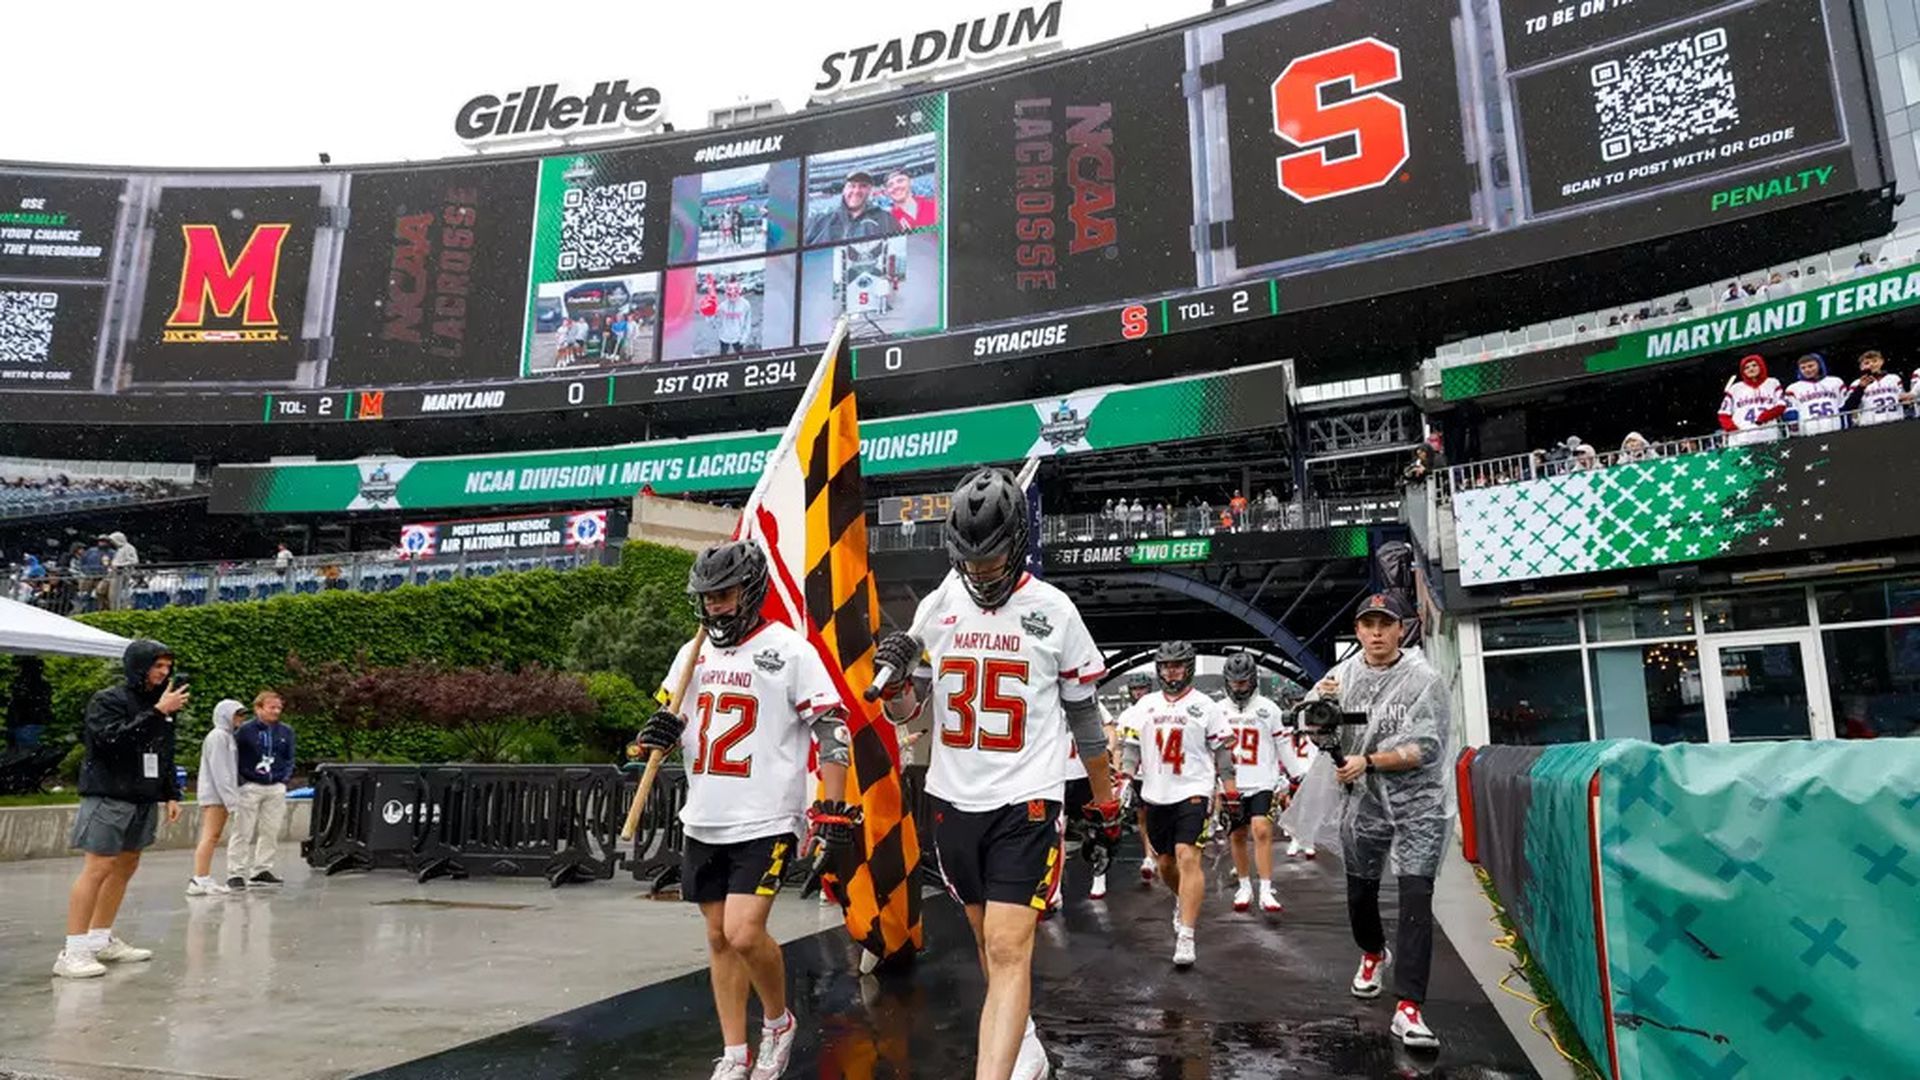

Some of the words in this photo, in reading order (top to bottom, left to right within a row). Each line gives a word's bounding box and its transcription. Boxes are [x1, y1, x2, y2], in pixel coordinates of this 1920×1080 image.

[1525, 15, 1547, 34] TO
[1552, 6, 1575, 27] BE
[1580, 0, 1605, 18] ON
[814, 0, 1064, 91] STADIUM
[454, 79, 663, 140] Gillette
[1271, 36, 1410, 203] S
[694, 134, 784, 163] #NCAAMLAX
[1561, 176, 1601, 196] SCAN
[1605, 171, 1624, 185] TO
[1628, 161, 1670, 180] POST
[1672, 148, 1716, 169] WITH
[1720, 140, 1745, 157] QR
[1749, 127, 1795, 149] CODE
[1014, 97, 1056, 291] LACROSSE
[1065, 102, 1118, 255] NCAA
[1711, 165, 1834, 211] PENALTY
[20, 198, 46, 210] USE
[2, 243, 26, 255] THE
[27, 244, 102, 258] VIDEOBOARD
[33, 229, 82, 242] CHANCE
[166, 223, 292, 326] M
[380, 210, 435, 343] NCAA
[1178, 304, 1215, 321] TOL:
[1232, 290, 1249, 314] 2
[974, 324, 1068, 356] SYRACUSE
[1122, 303, 1148, 340] S
[1646, 300, 1807, 358] MARYLAND
[884, 347, 902, 370] 0
[654, 377, 687, 395] 1ST
[692, 371, 729, 392] QTR
[744, 360, 797, 388] 2:34
[279, 401, 306, 414] TOL:
[318, 397, 333, 414] 2
[360, 391, 385, 419] M
[421, 390, 505, 412] MARYLAND
[567, 382, 584, 404] 0
[464, 471, 514, 493] NCAA
[519, 464, 605, 492] DIVISION
[609, 465, 618, 486] I
[621, 457, 682, 483] MEN'S
[441, 538, 460, 553] AIR
[462, 533, 517, 551] NATIONAL
[519, 530, 561, 547] GUARD
[1083, 546, 1122, 562] GAME
[1137, 544, 1169, 560] TWO
[1172, 542, 1206, 558] FEET
[953, 632, 1020, 652] MARYLAND
[938, 656, 1030, 752] 35
